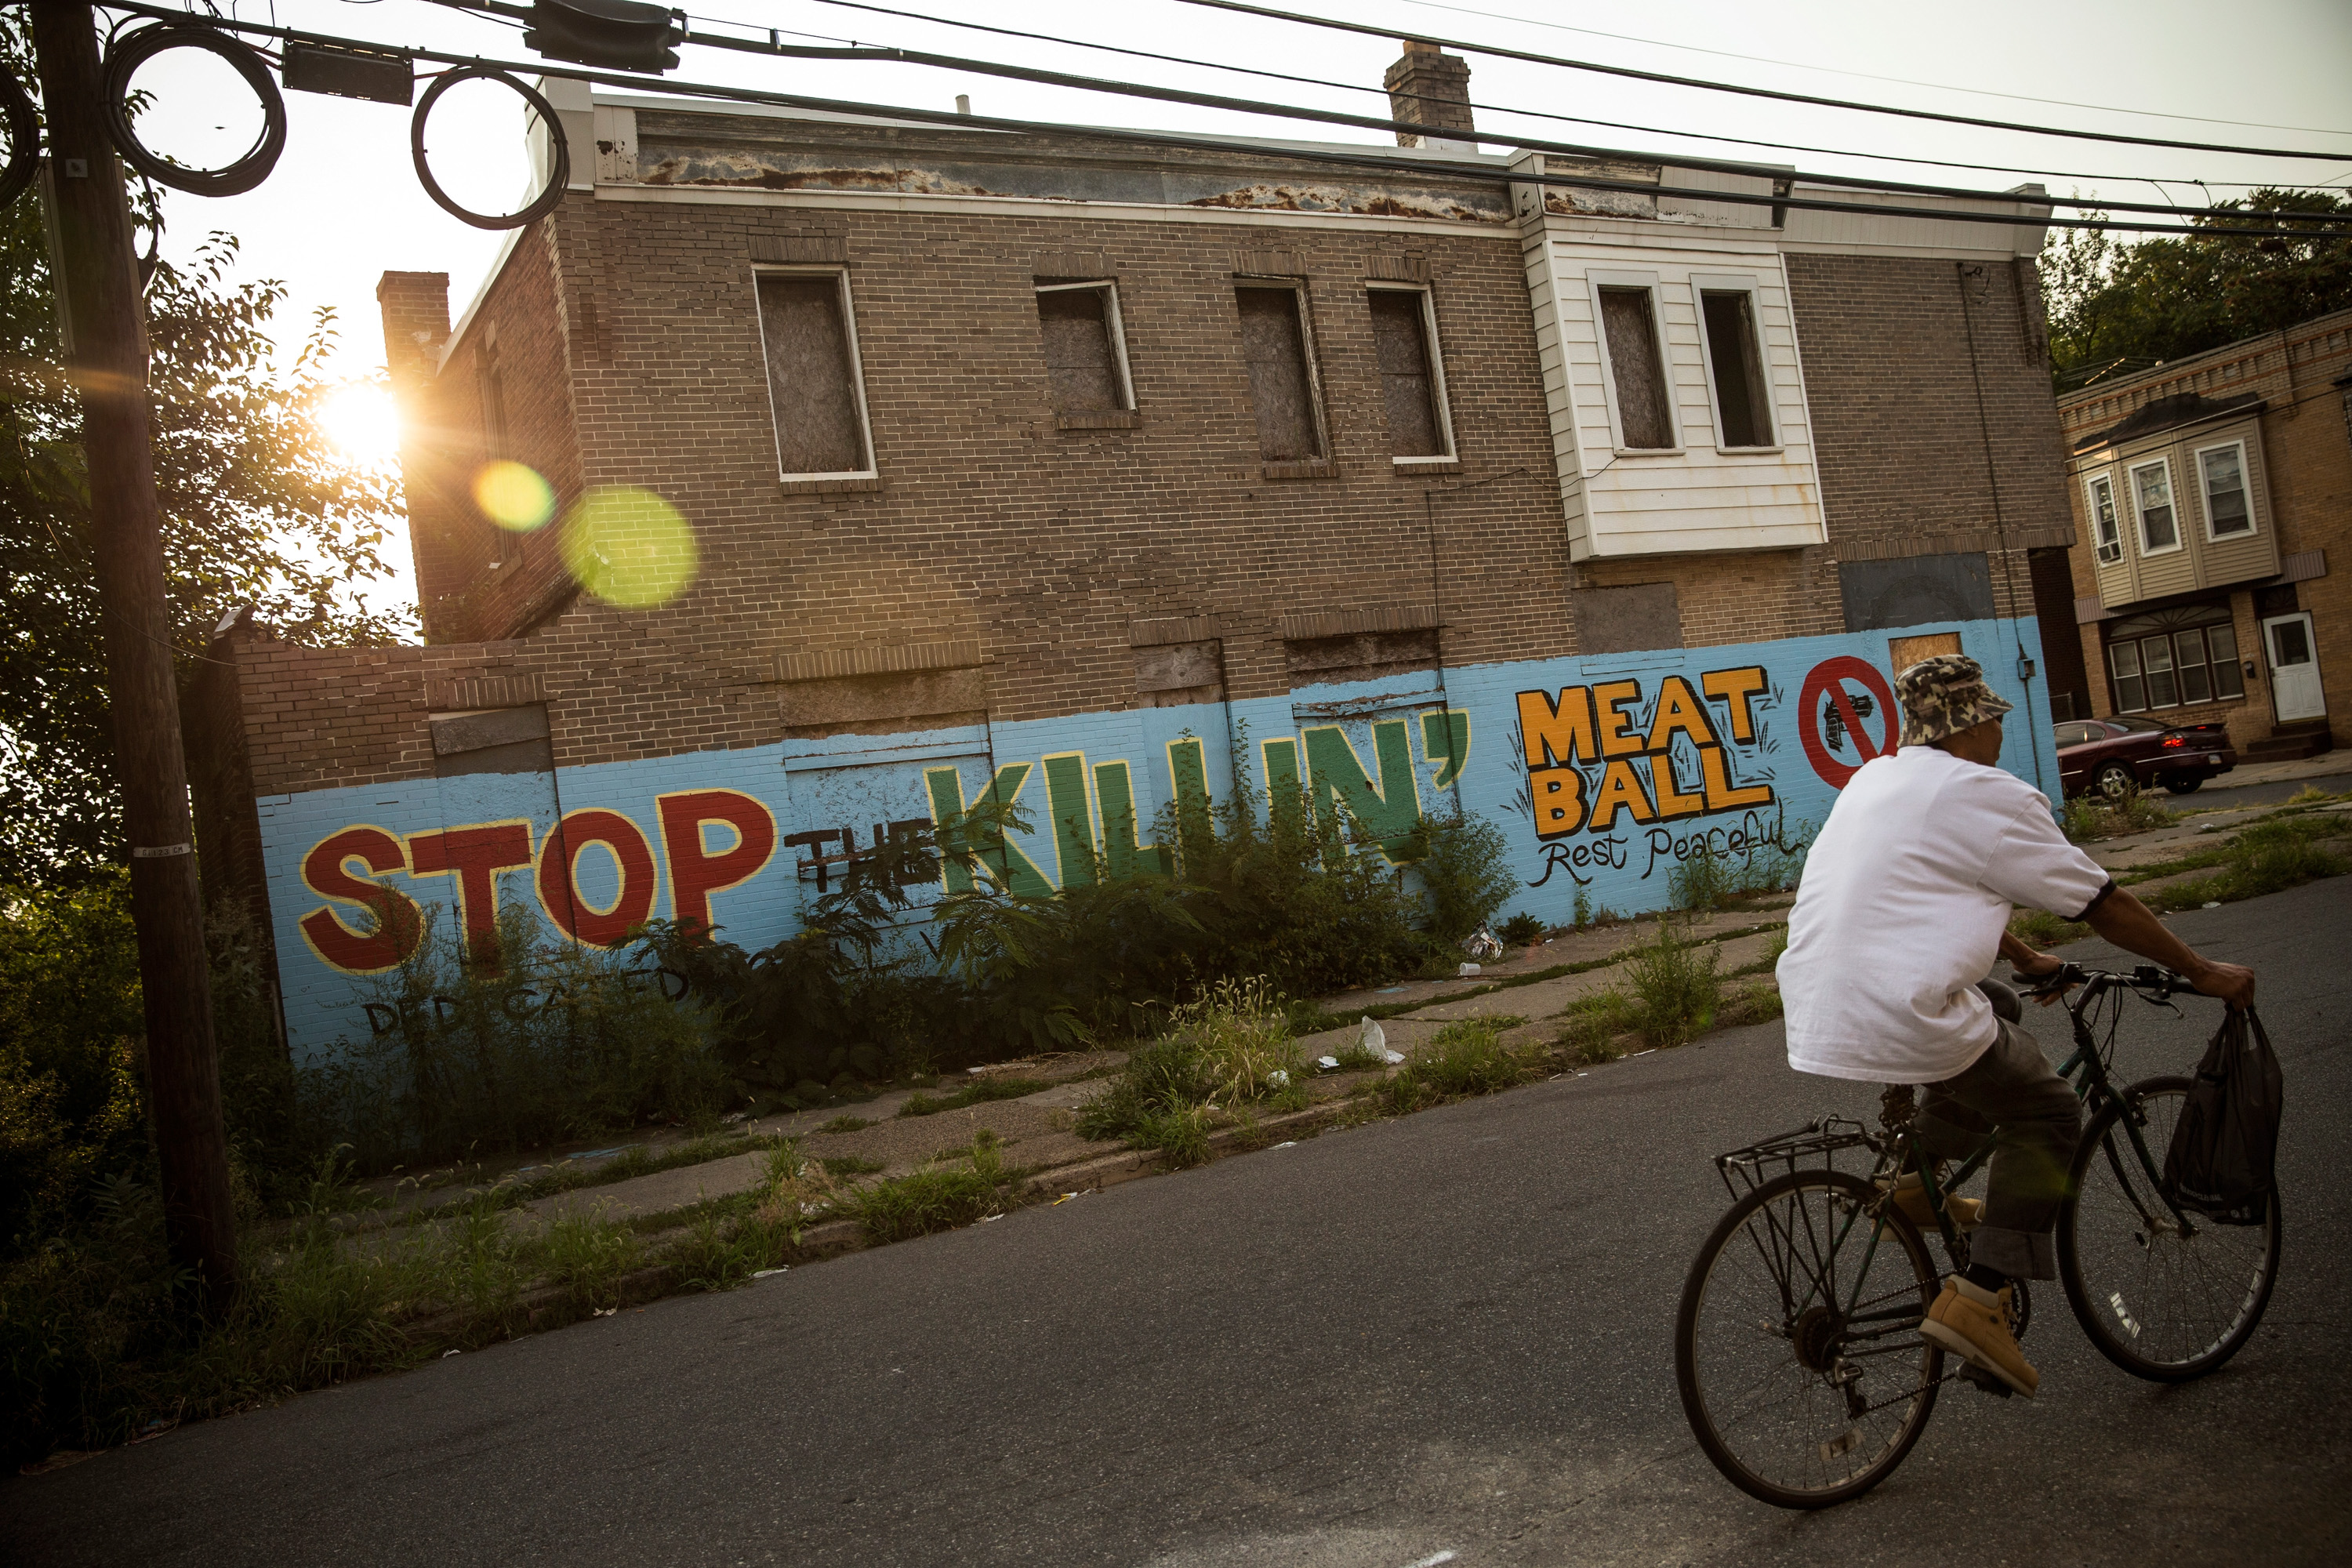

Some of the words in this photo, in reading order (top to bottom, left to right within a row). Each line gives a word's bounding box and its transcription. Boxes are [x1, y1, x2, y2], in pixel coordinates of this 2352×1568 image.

[1515, 665, 1769, 771] MEAT
[1526, 833, 1628, 887] Rest
[1641, 796, 1804, 880] Peaceful
[1528, 745, 1776, 841] BALL
[298, 787, 779, 983] STOP
[784, 817, 942, 893] THE
[923, 707, 1471, 900] KILLIN'
